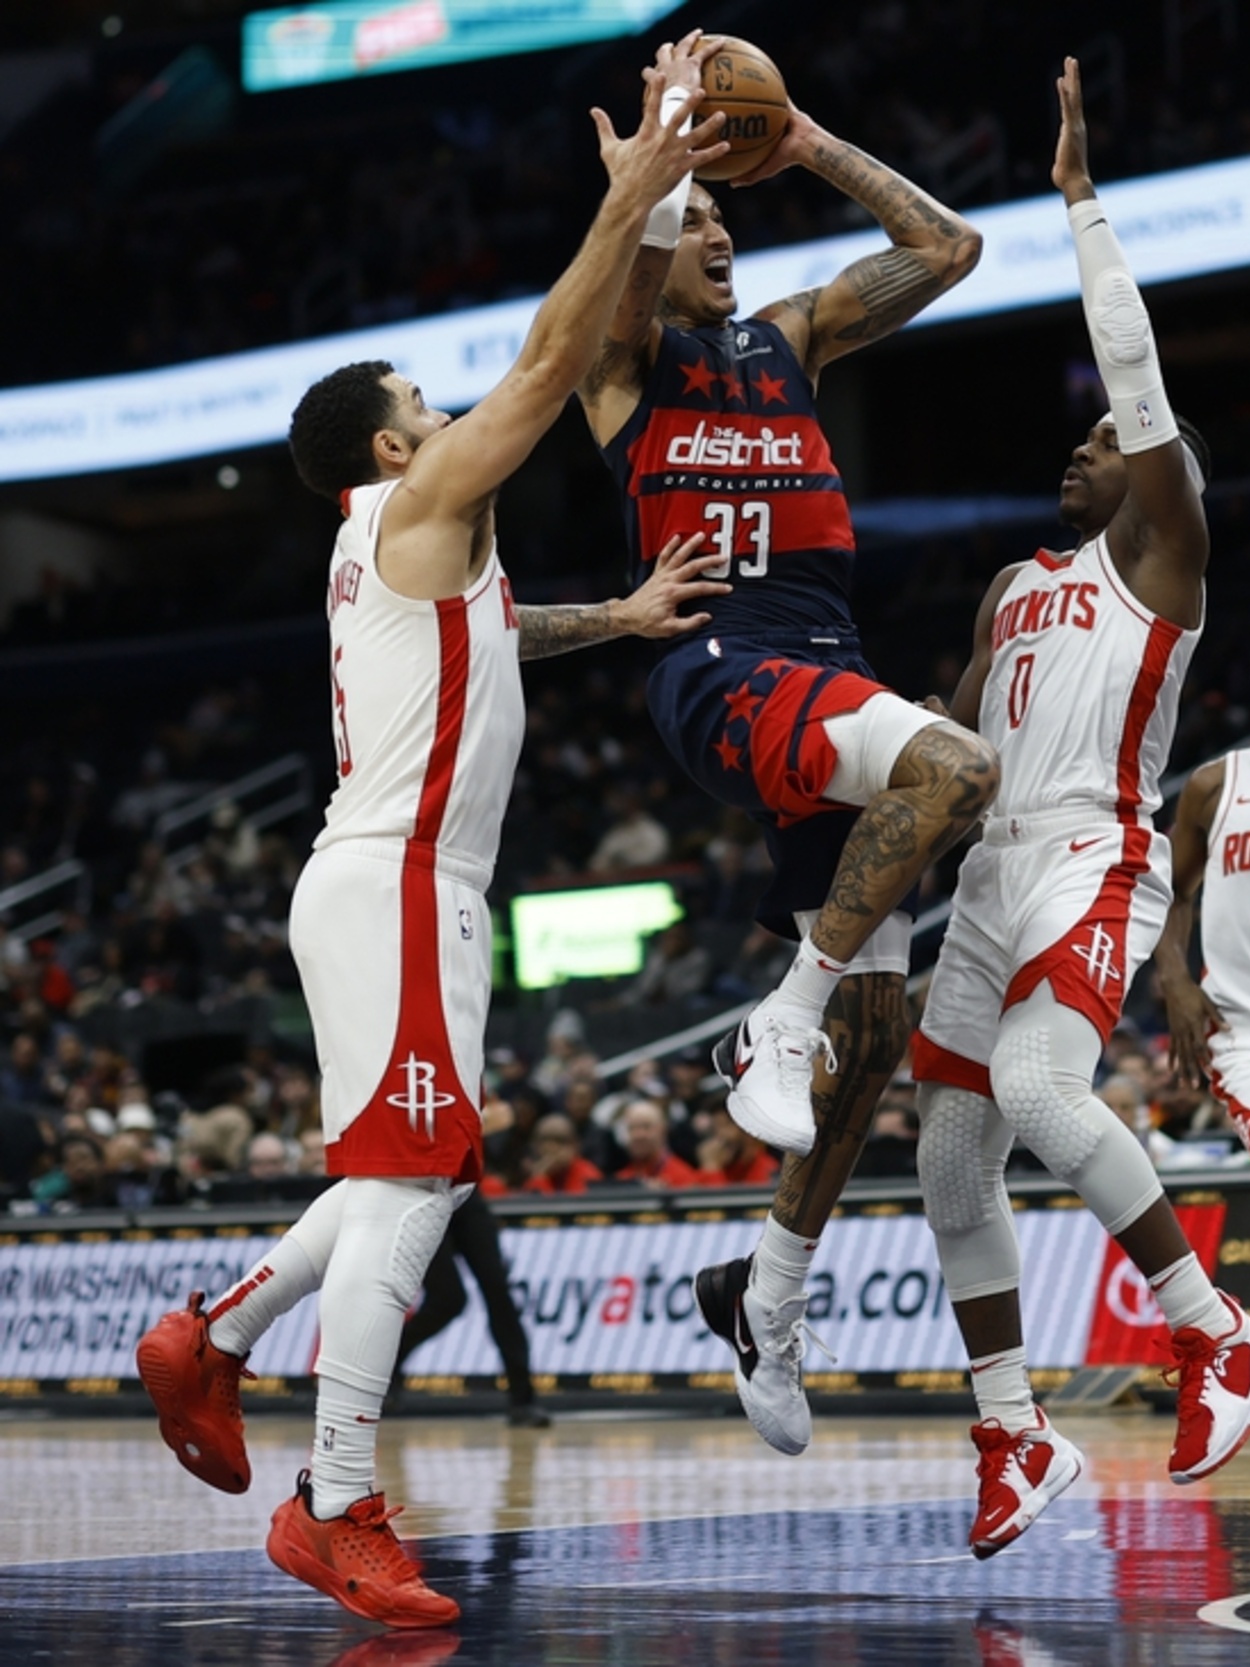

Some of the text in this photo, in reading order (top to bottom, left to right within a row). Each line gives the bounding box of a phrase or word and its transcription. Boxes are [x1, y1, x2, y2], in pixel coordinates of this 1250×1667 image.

[666, 419, 803, 466] district
[700, 502, 771, 580] 33
[1008, 652, 1035, 730] 0
